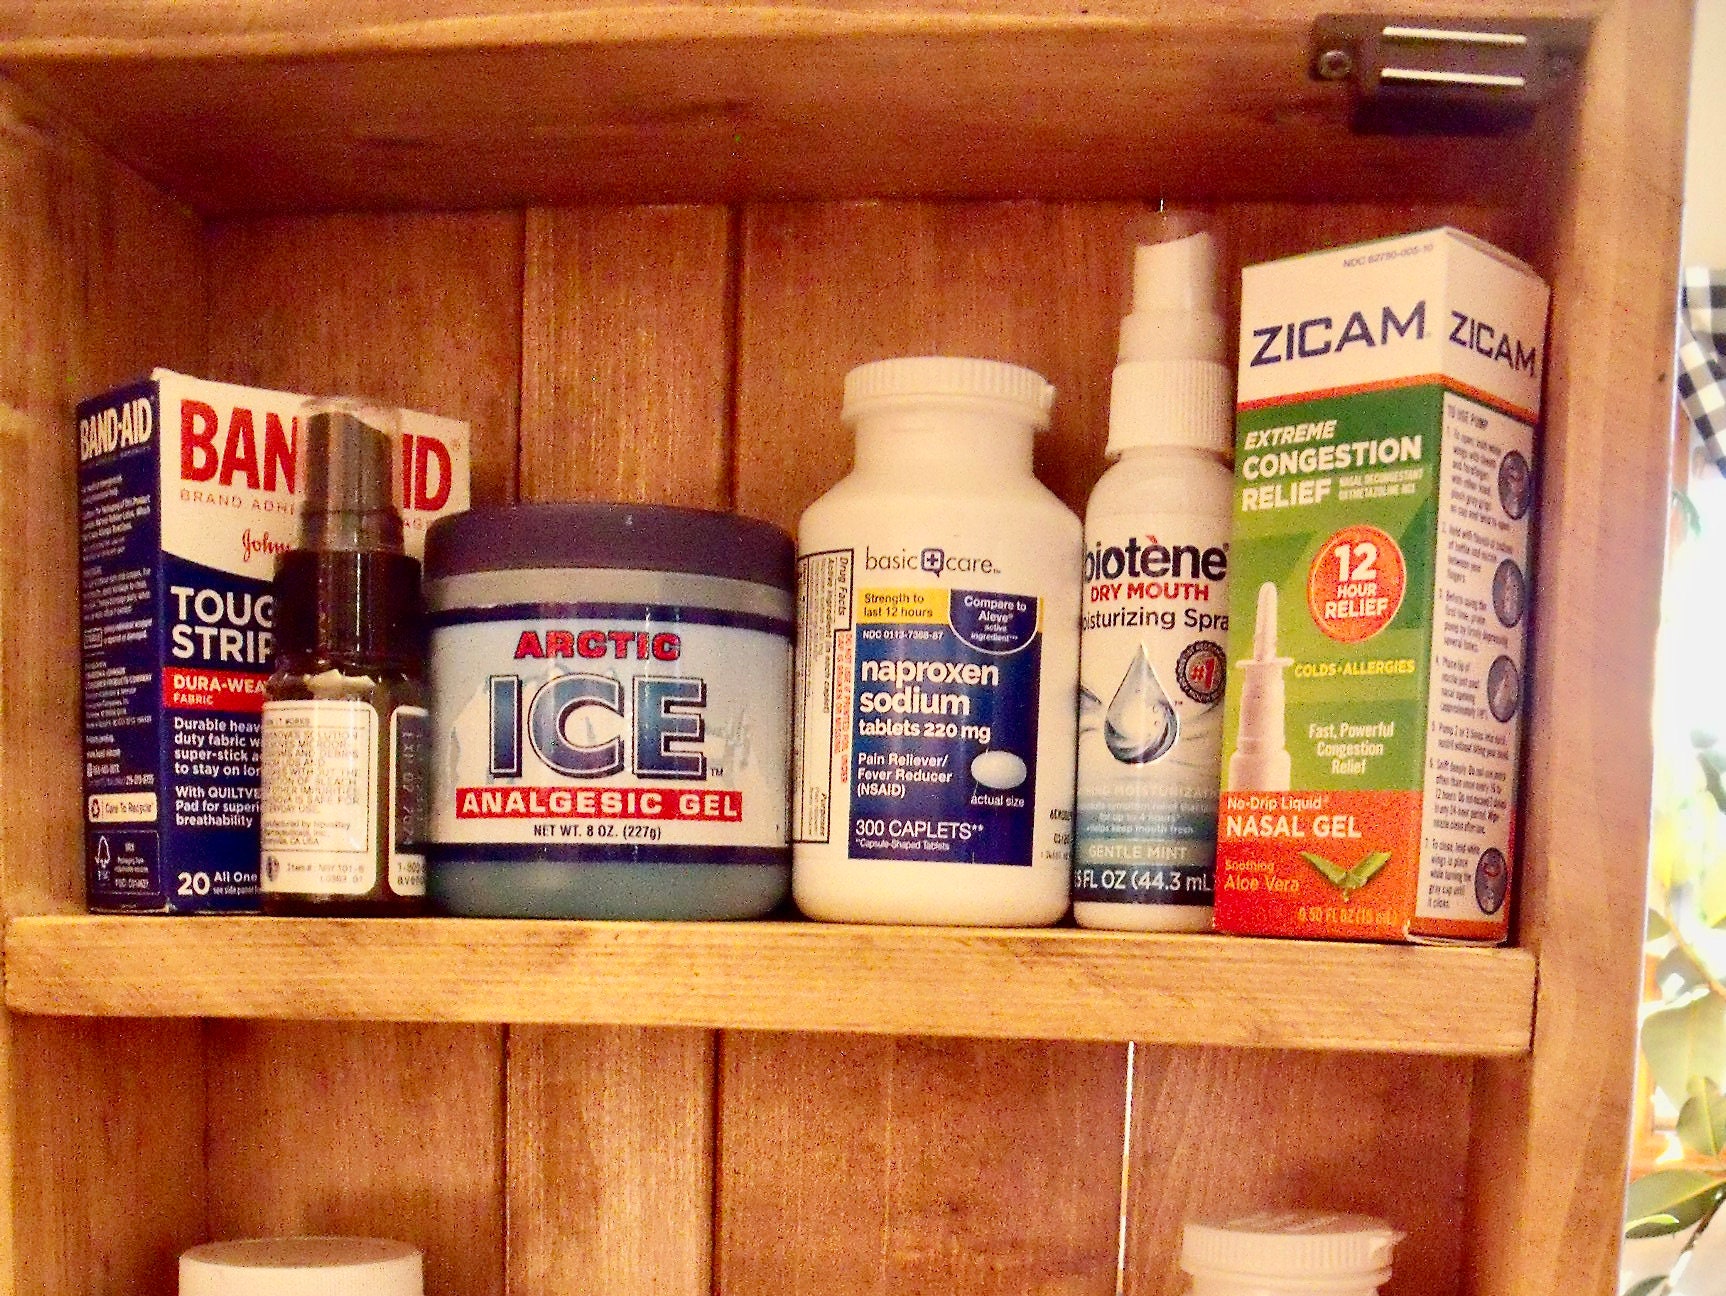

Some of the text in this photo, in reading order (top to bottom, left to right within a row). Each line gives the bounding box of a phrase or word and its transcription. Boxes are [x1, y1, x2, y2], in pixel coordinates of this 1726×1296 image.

[1250, 300, 1427, 367] ZICAM
[1449, 311, 1536, 377] ZICAM
[80, 397, 152, 461] BAND-AID
[1244, 420, 1337, 450] EXTREME
[1242, 435, 1422, 480] CONGESTION
[180, 487, 242, 509] BRAND
[1242, 478, 1331, 512] RELIEF
[866, 546, 994, 574] basic care
[1334, 542, 1378, 583] 12
[864, 593, 925, 607] Strength to
[1091, 581, 1209, 602] DRY MOUTH
[1337, 583, 1377, 598] HOUR
[170, 585, 275, 629] TOUG
[864, 607, 934, 618] last 12 hours
[964, 595, 1027, 613] Compare to
[1324, 597, 1388, 620] RELIEF
[1184, 608, 1230, 633] Spra
[172, 623, 273, 664] STRIP
[863, 630, 882, 640] NDC
[514, 630, 682, 662] ARCTIC
[861, 659, 999, 689] naproxen
[1192, 657, 1216, 690] #1
[173, 673, 267, 695] DURA-WEA
[173, 692, 214, 706] FABRIC
[859, 685, 970, 716] sodium
[174, 716, 227, 732] Durable
[489, 672, 708, 781] ICE
[858, 718, 991, 745] tablets 220 mg
[1340, 721, 1394, 738] Powerful
[174, 732, 247, 748] duty fabric
[1316, 740, 1384, 758] Congestion
[174, 748, 249, 764] super-stick
[858, 752, 950, 768] Pain Reliever/
[174, 762, 240, 779] to stay on
[857, 768, 953, 784] Fever Reducer
[1331, 758, 1365, 775] Relief
[175, 785, 205, 800] With
[857, 782, 907, 799] (NSAID)
[175, 800, 220, 813] Pad for
[462, 790, 739, 818] ANALGESIC GEL
[970, 794, 1026, 808] actual size
[1228, 795, 1322, 812] No-Drip Liquid
[176, 814, 253, 829] breathability
[855, 818, 885, 837] 300
[1227, 815, 1362, 838] NASAL GEL
[534, 825, 662, 841] NET WT. 8 OZ. (227g)
[1089, 845, 1188, 860] GENTLE MINT
[177, 871, 211, 896] 20
[213, 871, 229, 883] All
[233, 872, 258, 884] One
[1102, 870, 1127, 890] OZ
[1224, 875, 1300, 893] Aloe Vera
